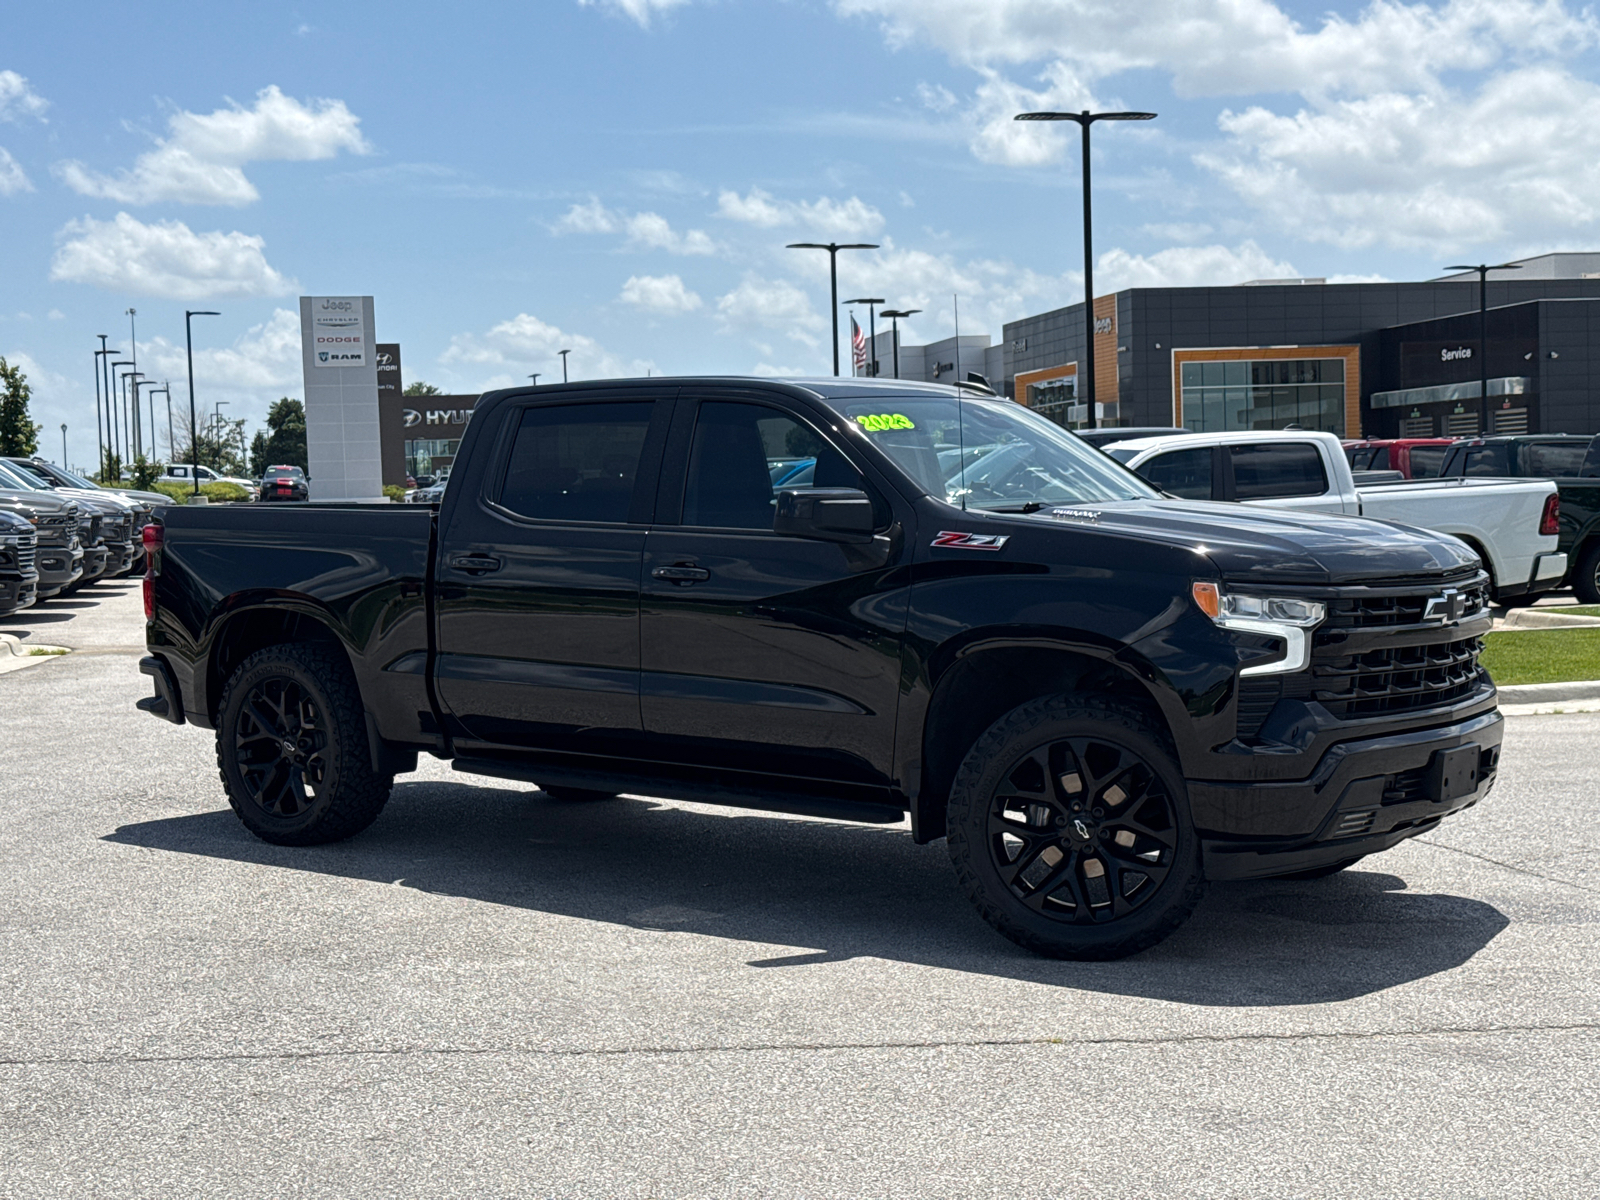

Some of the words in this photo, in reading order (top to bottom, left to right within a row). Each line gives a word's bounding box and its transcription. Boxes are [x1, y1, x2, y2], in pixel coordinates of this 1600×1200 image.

[321, 298, 352, 312] Jeep
[1441, 346, 1472, 362] Service
[930, 530, 1011, 552] Z71
